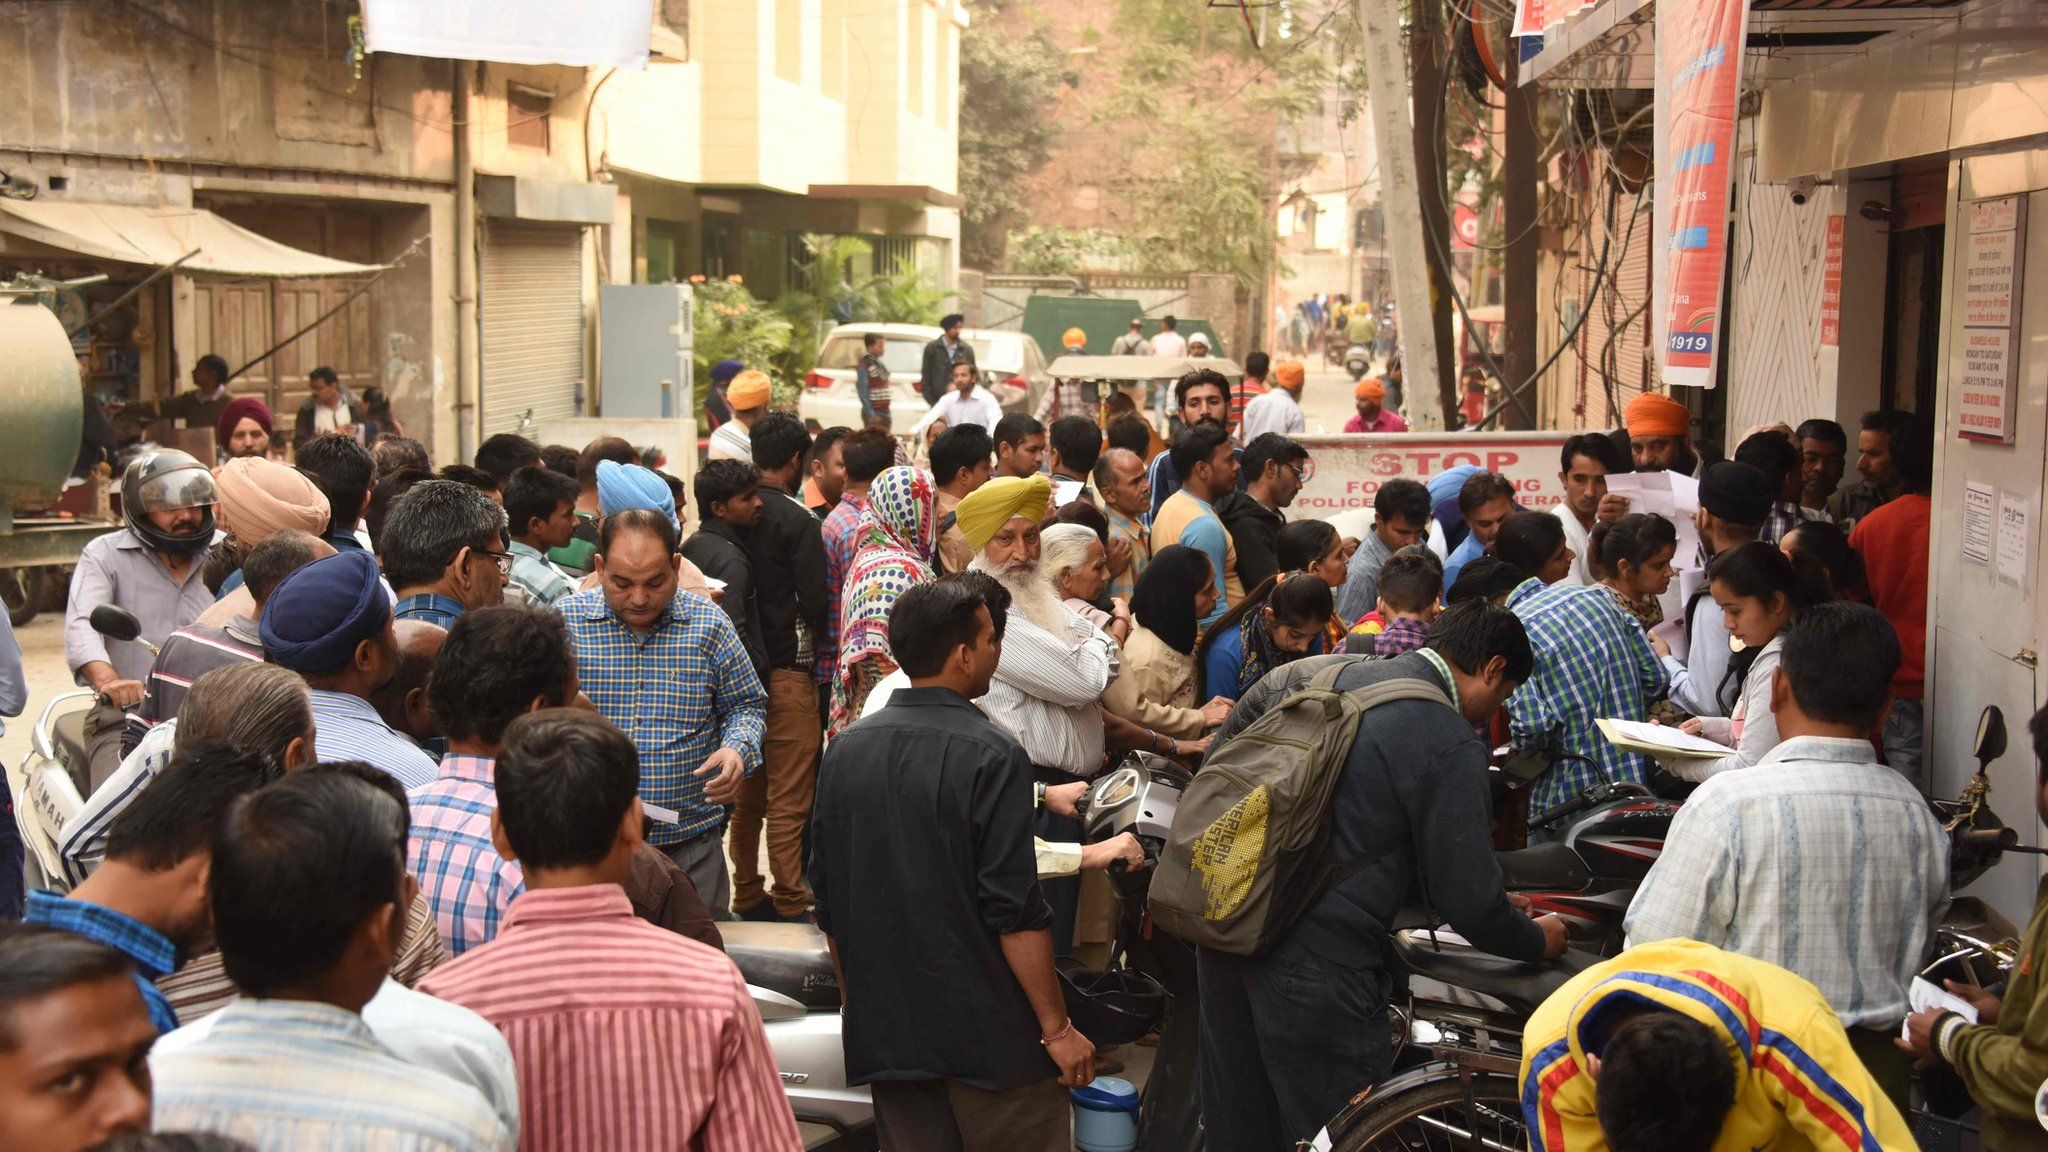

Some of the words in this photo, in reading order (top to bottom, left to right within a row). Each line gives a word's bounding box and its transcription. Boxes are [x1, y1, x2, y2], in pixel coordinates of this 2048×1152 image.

[1671, 335, 1707, 351] 1919
[1371, 452, 1519, 476] STOP
[1347, 481, 1383, 494] FO
[1298, 498, 1376, 508] POLICE
